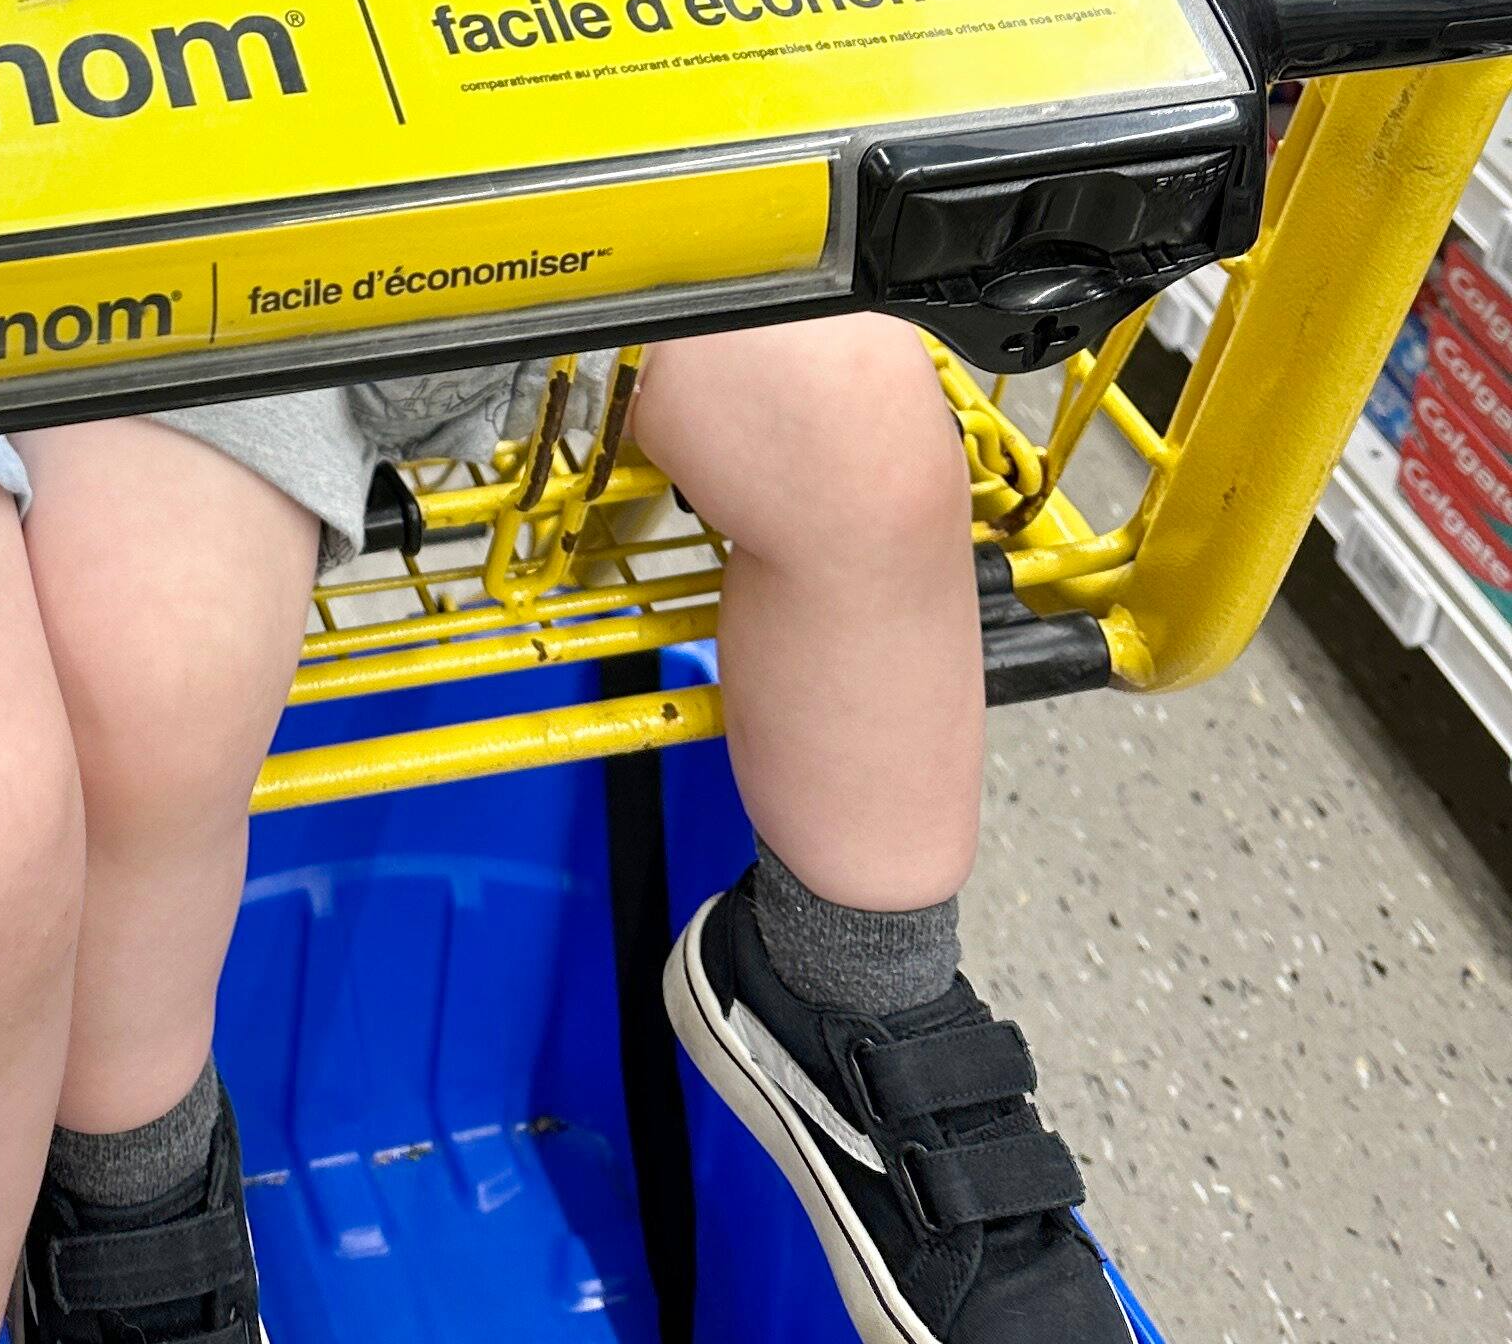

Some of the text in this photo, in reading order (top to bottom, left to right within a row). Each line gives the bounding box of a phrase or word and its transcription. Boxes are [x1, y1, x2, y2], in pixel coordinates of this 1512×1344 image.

[460, 69, 573, 93] comparativement
[575, 68, 591, 80] au
[593, 64, 618, 80] prix
[621, 59, 670, 75] courant
[732, 41, 814, 62] comparables
[815, 40, 831, 52] de
[833, 34, 888, 50] marques
[890, 26, 954, 44] nationales
[998, 16, 1028, 32] dans
[1029, 14, 1054, 26] nos
[248, 278, 344, 316] facile
[1448, 265, 1512, 348] Colg
[1434, 335, 1512, 431] Colga
[1403, 457, 1512, 587] Colgate
